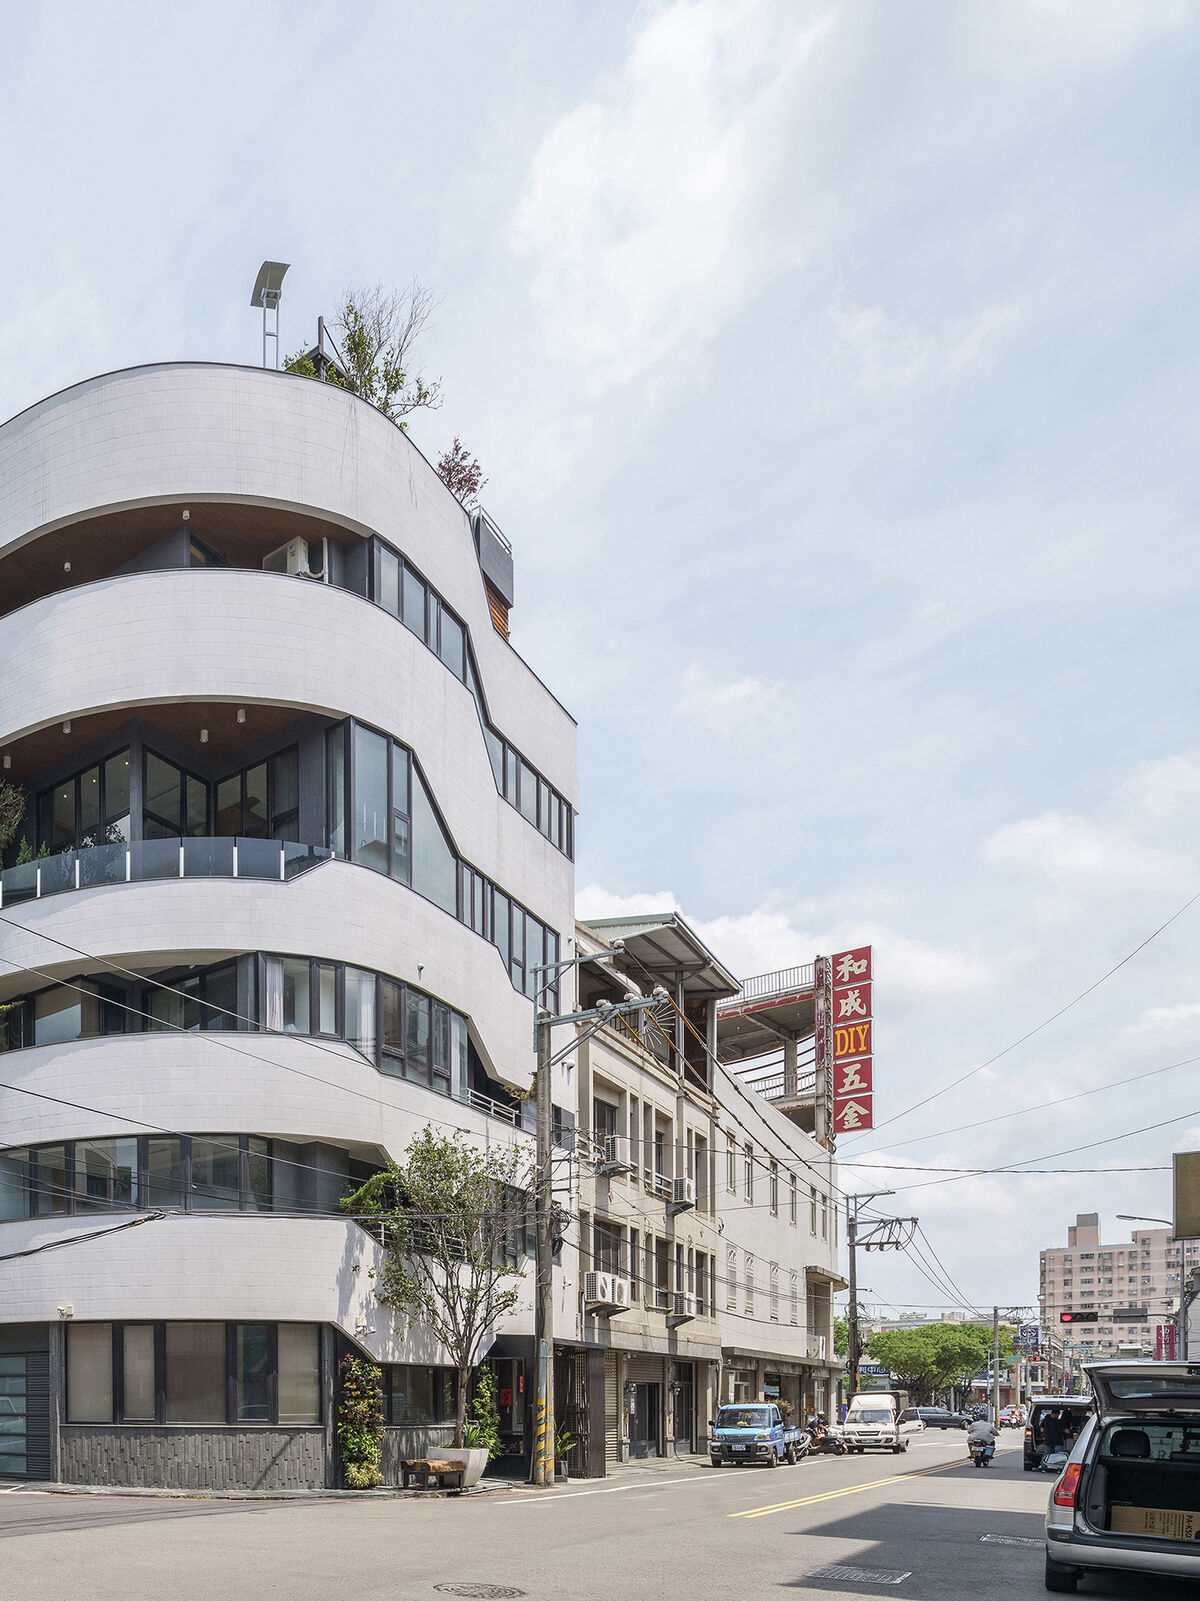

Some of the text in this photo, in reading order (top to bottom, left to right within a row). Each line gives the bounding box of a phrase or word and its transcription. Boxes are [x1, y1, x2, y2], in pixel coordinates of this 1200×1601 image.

[835, 954, 869, 1129] 和成 DIY 五金
